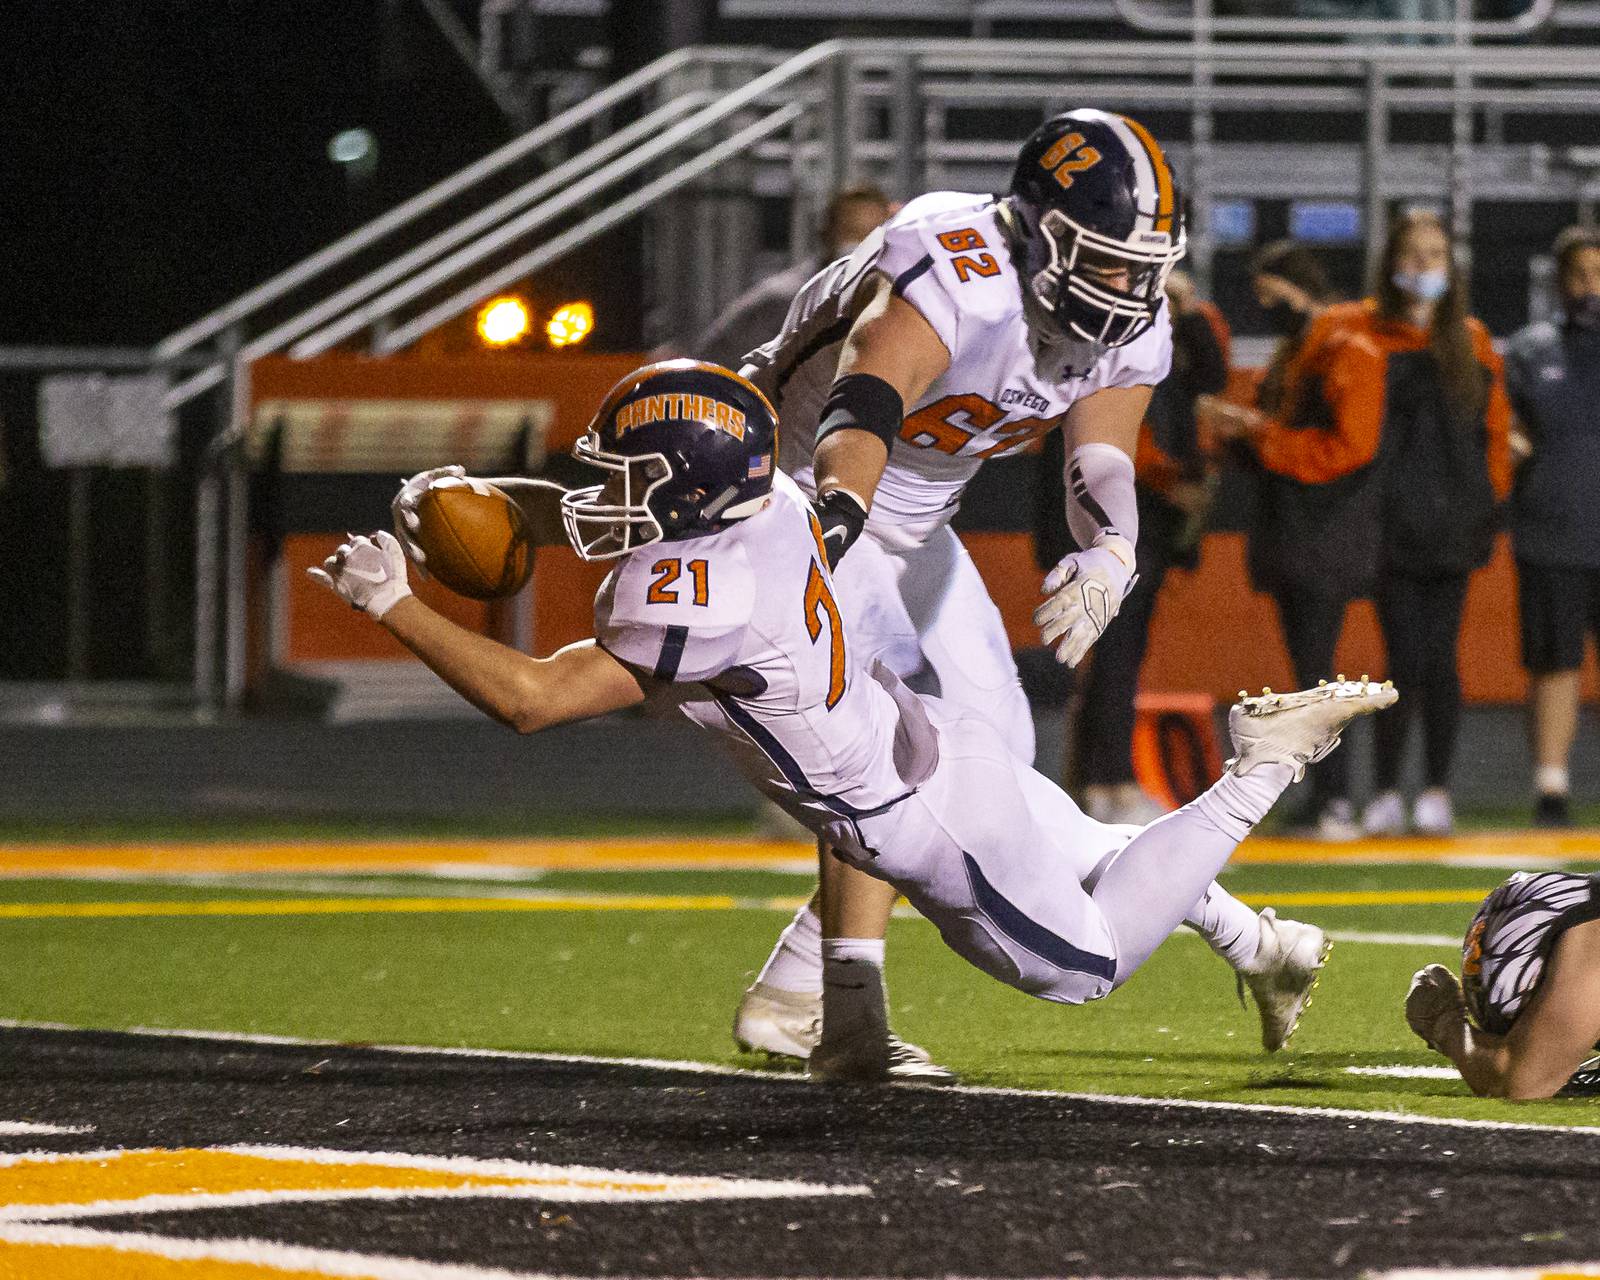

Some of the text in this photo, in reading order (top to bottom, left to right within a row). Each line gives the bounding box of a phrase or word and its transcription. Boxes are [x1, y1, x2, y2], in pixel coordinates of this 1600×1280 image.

[1039, 132, 1103, 189] 62
[935, 227, 1002, 283] 62
[615, 393, 746, 443] PANTHERS
[646, 558, 709, 607] 21
